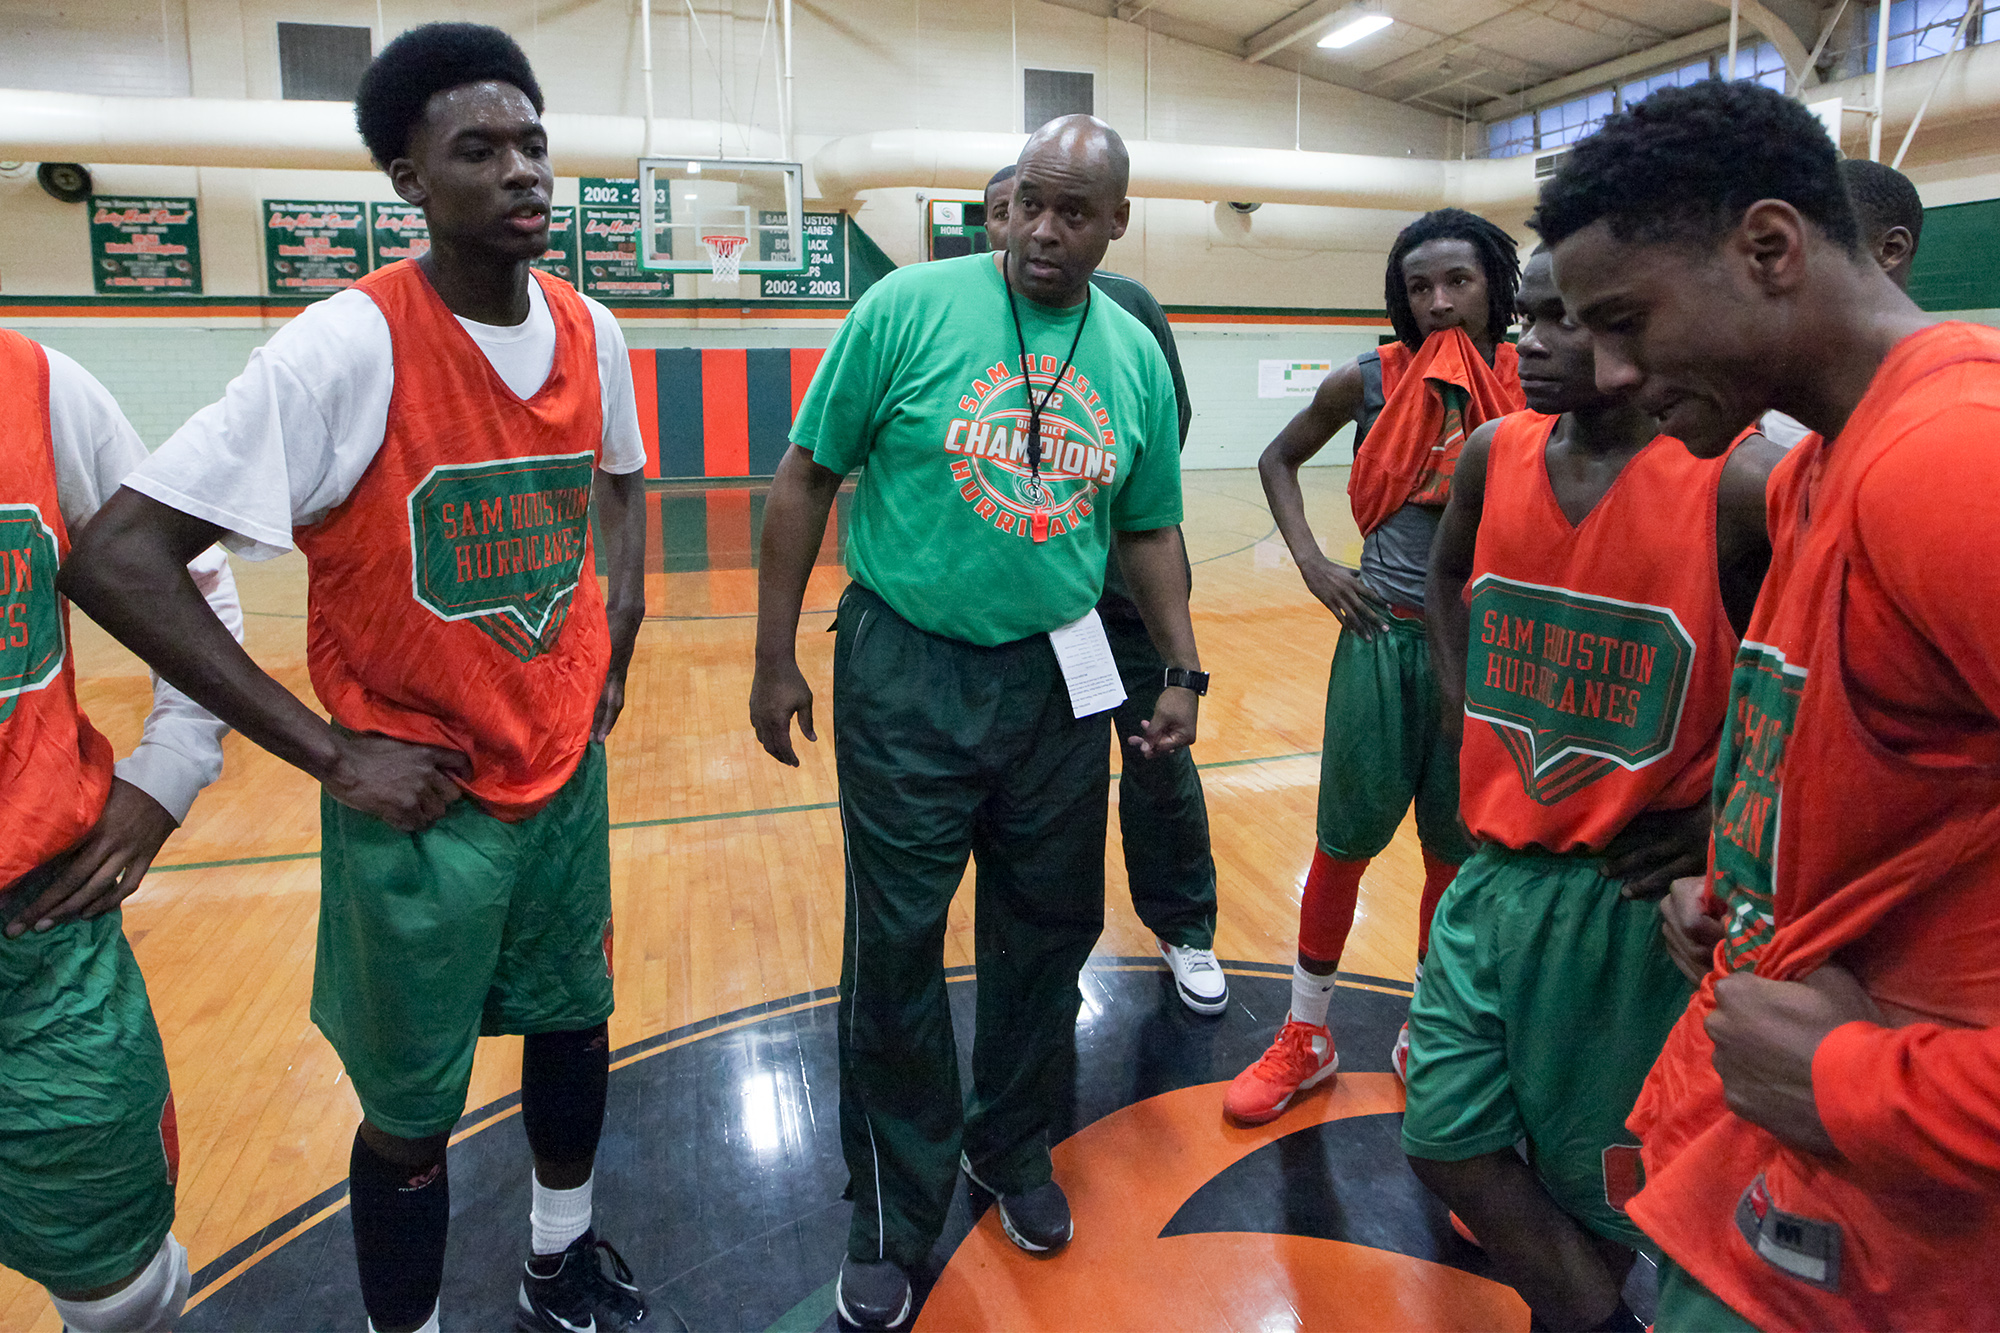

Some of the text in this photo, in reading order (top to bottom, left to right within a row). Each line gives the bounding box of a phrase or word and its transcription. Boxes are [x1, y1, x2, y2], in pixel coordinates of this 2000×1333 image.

[584, 187, 619, 202] 2002
[940, 226, 963, 235] HOME
[765, 280, 797, 294] 2002
[808, 281, 841, 295] 2003
[958, 353, 1116, 446] SAM HOUSTON
[1027, 388, 1064, 411] 2012
[1016, 418, 1067, 437] DIRICT
[944, 418, 1118, 486] CHAMPIONS
[442, 485, 588, 539] SAM HOUSTON
[949, 459, 1099, 537] HURRIANE
[455, 526, 580, 583] HURRICANES
[1481, 610, 1535, 655] SAM
